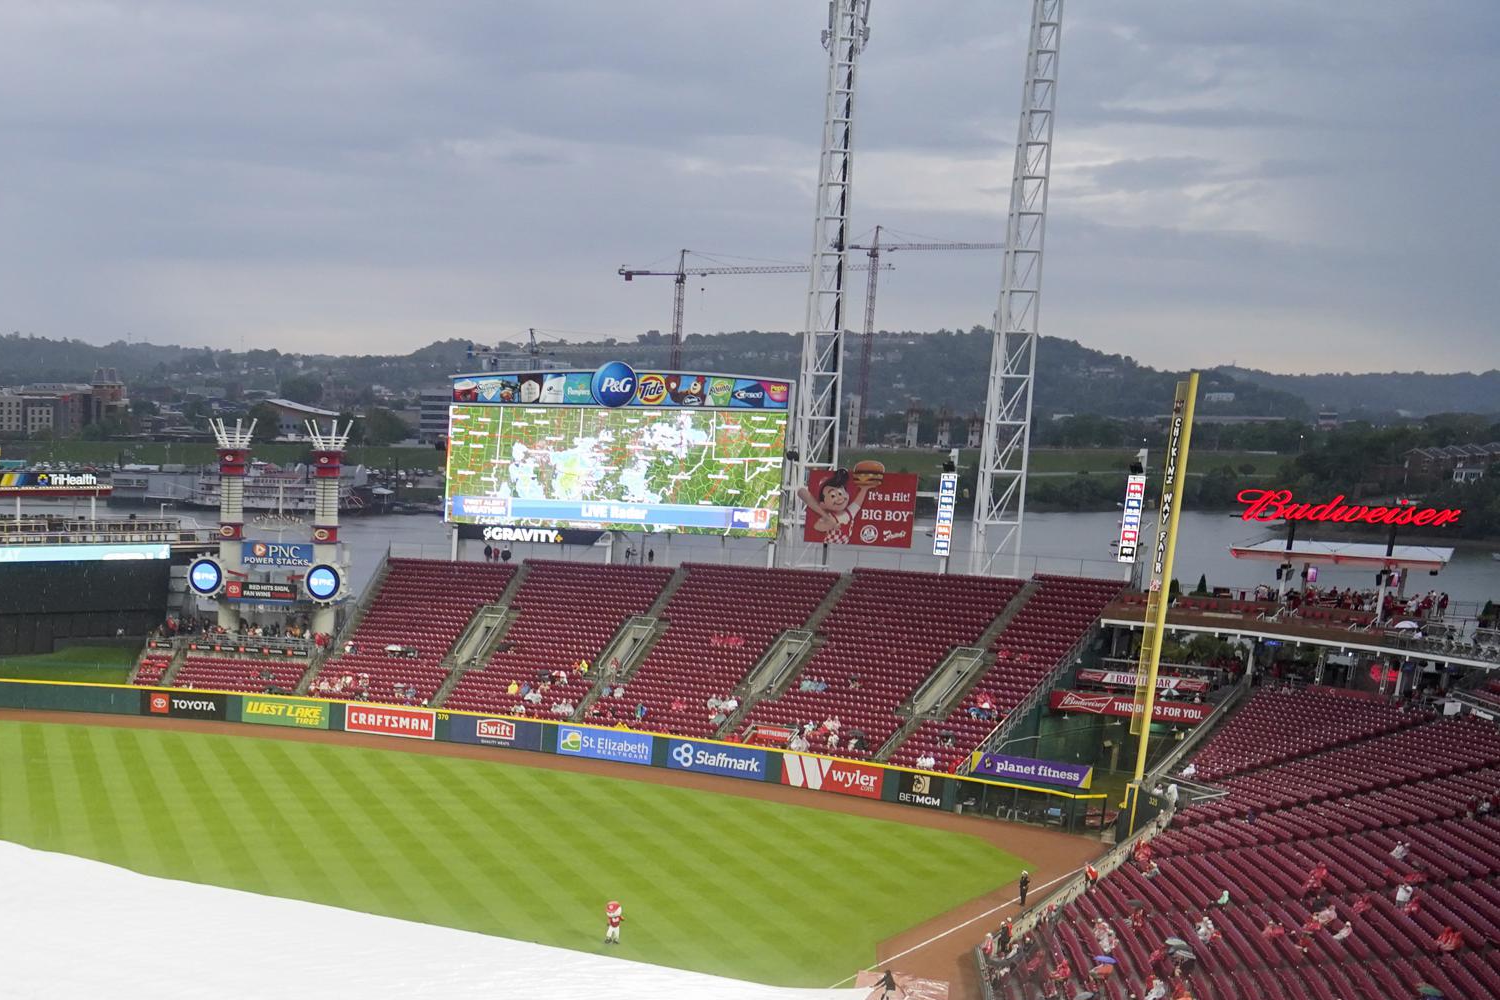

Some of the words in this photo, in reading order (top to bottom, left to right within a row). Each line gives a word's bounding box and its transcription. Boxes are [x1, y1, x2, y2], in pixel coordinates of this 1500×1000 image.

[600, 377, 632, 394] P&G
[638, 382, 664, 397] Tide
[49, 474, 97, 486] TriHealth
[868, 491, 883, 501] It's
[892, 493, 911, 502] Hit!
[463, 506, 507, 516] WEATHER
[581, 504, 608, 519] LIVE
[610, 505, 647, 520] Radar
[861, 509, 882, 521] BIG
[885, 510, 910, 522] BOY
[1161, 493, 1173, 524] WAY
[1236, 488, 1463, 528] Budweiser
[269, 546, 301, 559] PNC
[1155, 531, 1167, 574] FAIR
[244, 556, 274, 565] POWER
[276, 557, 309, 566] STACKS
[172, 699, 216, 711] TOYOTA
[1064, 696, 1106, 709] Budweiser
[246, 702, 287, 715] WEST
[286, 705, 322, 719] LAKE
[437, 713, 449, 721] 370
[1114, 701, 1133, 712] THIS
[1163, 706, 1181, 718] FOR
[1183, 708, 1204, 720] YOU.
[295, 717, 320, 726] TIRES
[351, 712, 429, 731] CRAFTSMAN
[480, 722, 511, 738] Swift
[596, 738, 649, 756] Elizabeth
[597, 749, 649, 760] HEALTHCARE
[832, 769, 878, 788] wyler
[996, 761, 1035, 776] planet
[1037, 764, 1080, 781] fitness
[899, 792, 941, 807] BETMGM
